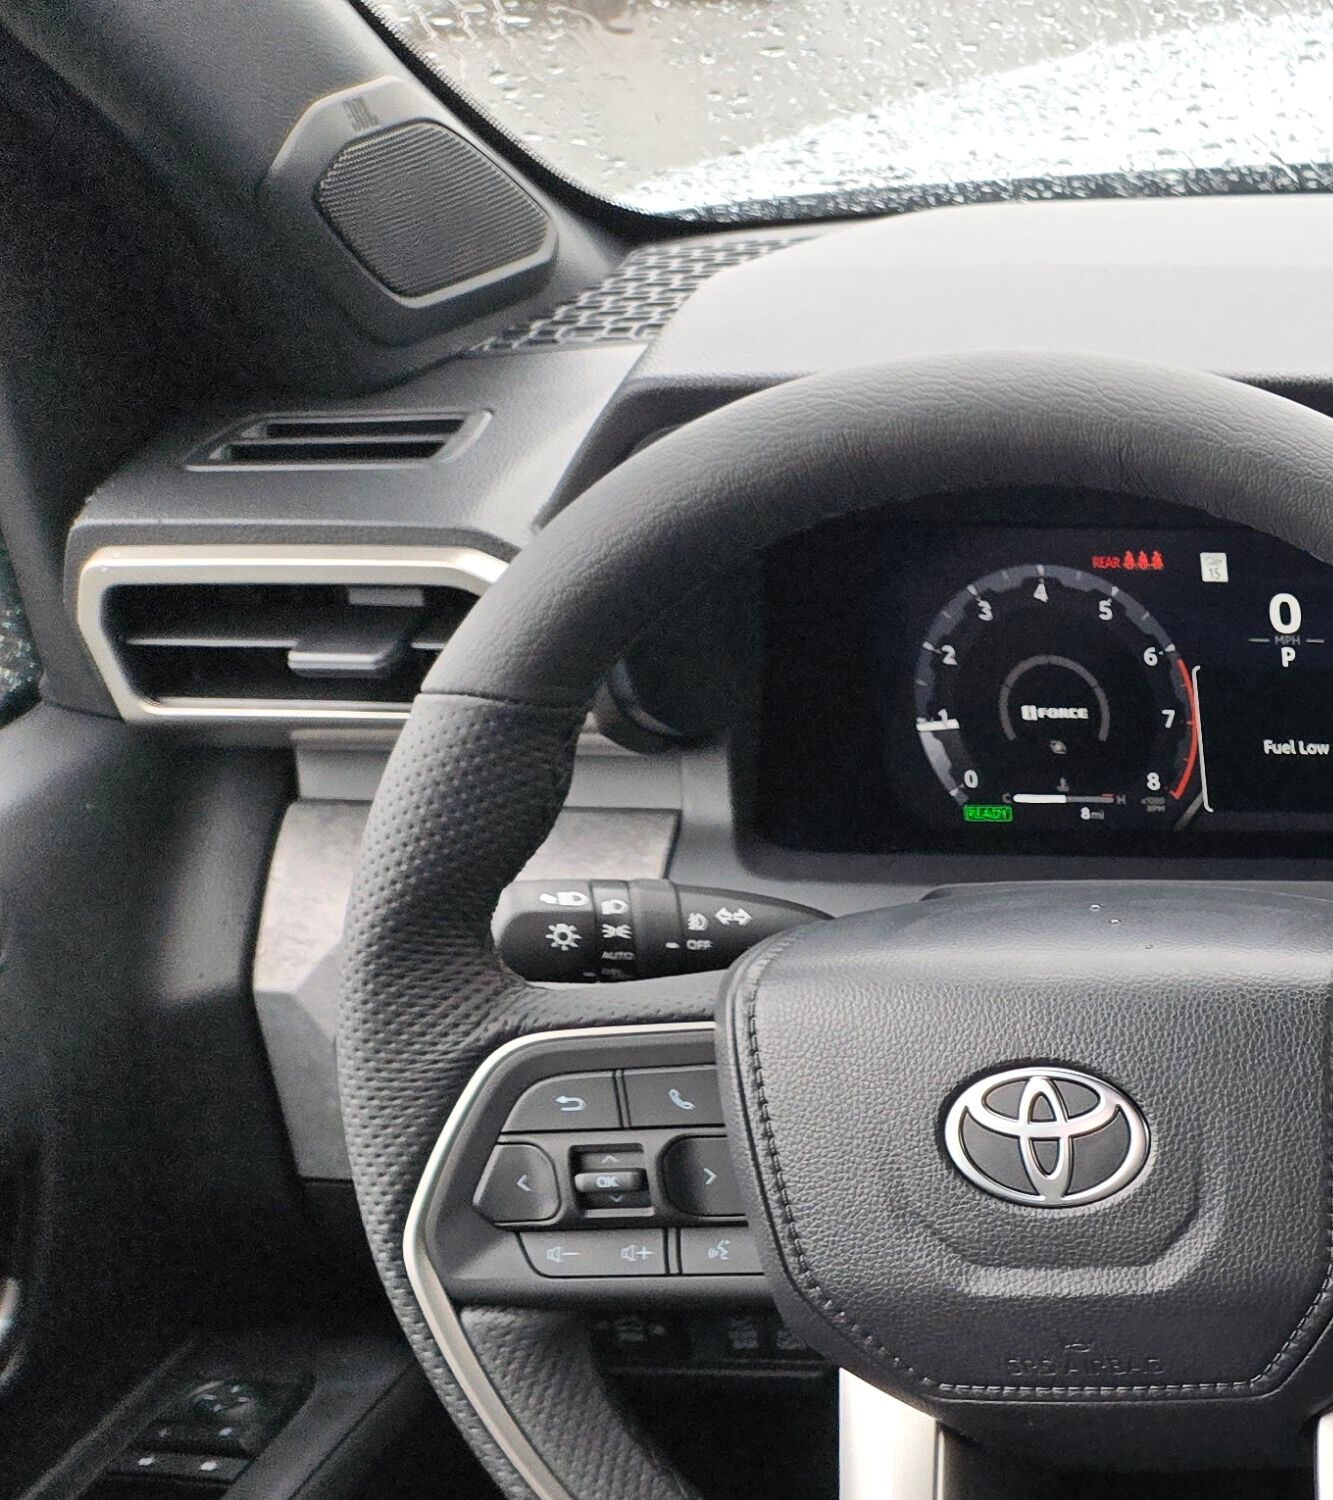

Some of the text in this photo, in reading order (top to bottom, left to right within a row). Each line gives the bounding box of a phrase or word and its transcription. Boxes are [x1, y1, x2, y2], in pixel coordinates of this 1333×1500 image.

[1092, 556, 1120, 569] REAR
[978, 600, 993, 621] 3
[1098, 599, 1113, 620] 5
[1269, 593, 1302, 634] 0
[1274, 635, 1301, 645] MPH
[941, 645, 958, 665] 2
[1143, 647, 1158, 666] 6
[1281, 647, 1295, 667] P
[1162, 709, 1176, 729] 7
[1263, 739, 1330, 756] Fuel Low
[964, 769, 978, 788] 0
[1146, 772, 1161, 790] 8
[601, 951, 635, 961] AUTO
[596, 1176, 619, 1188] OK
